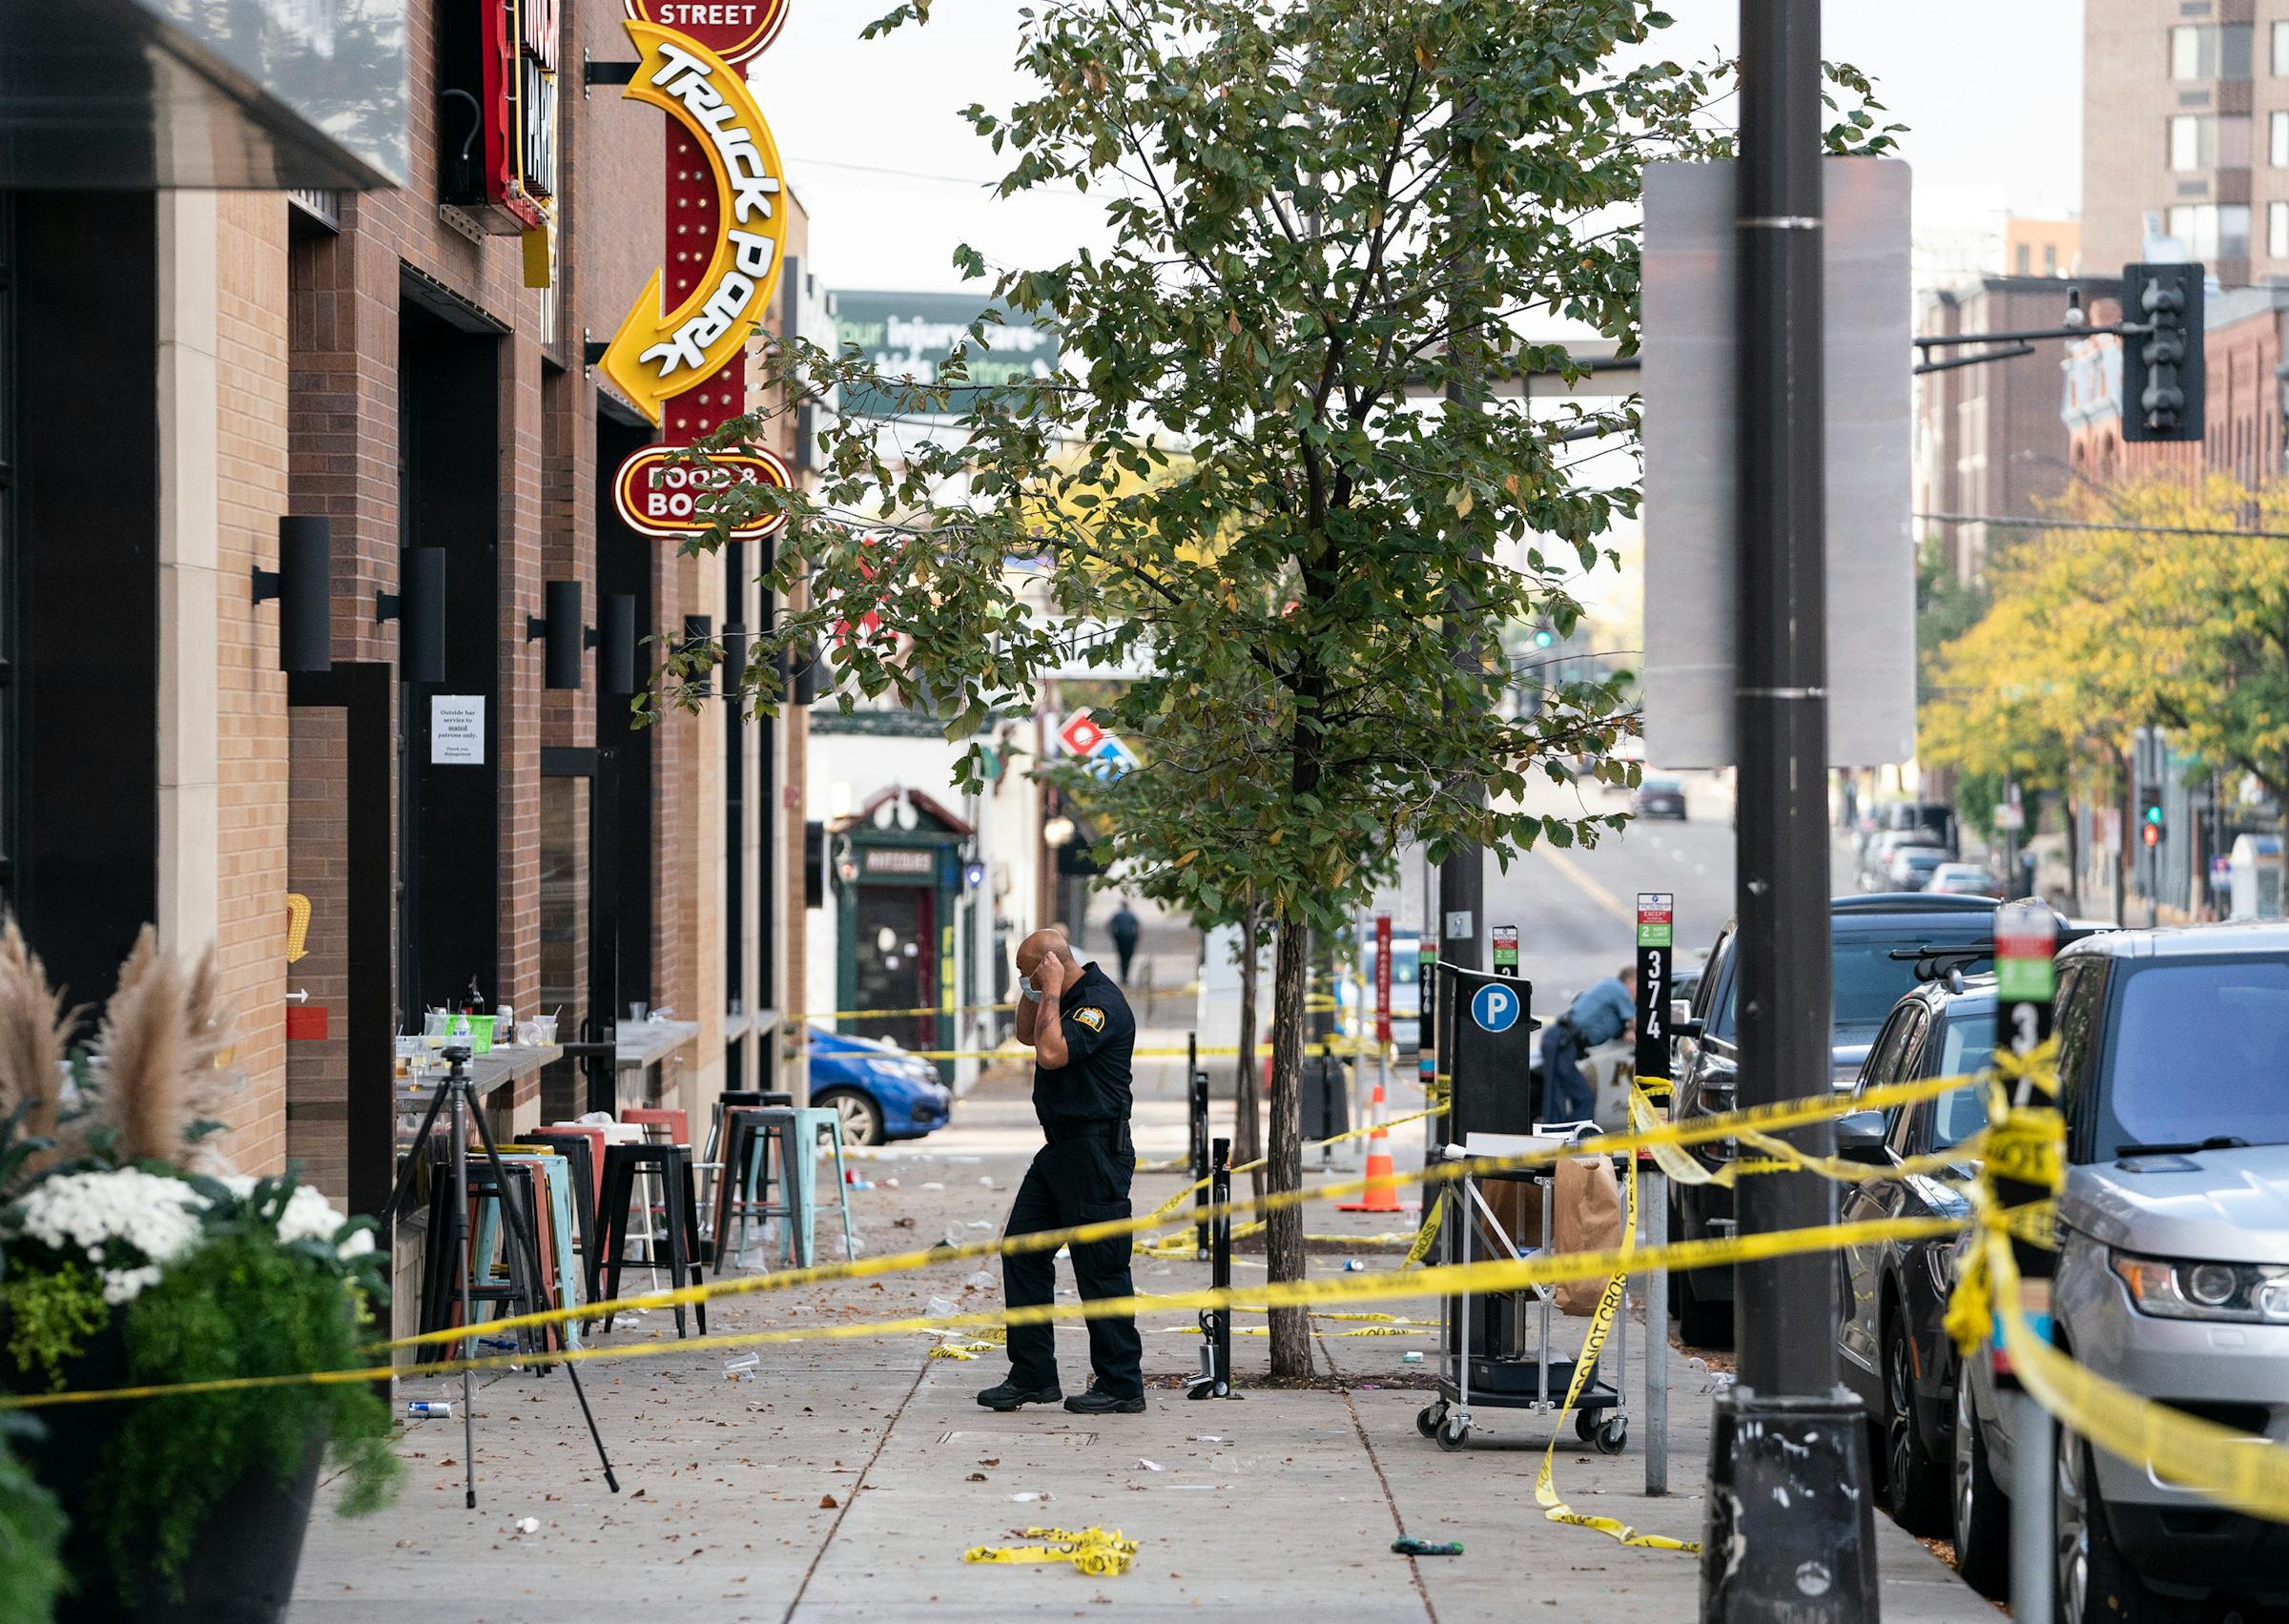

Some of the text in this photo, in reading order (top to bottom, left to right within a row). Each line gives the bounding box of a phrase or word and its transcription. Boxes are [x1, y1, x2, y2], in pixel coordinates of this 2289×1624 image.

[660, 4, 757, 25] STREET
[639, 41, 780, 378] TRUCK PARK
[648, 466, 732, 489] FOOD
[1641, 925, 1650, 937] 2
[1488, 993, 1508, 1025] P
[1646, 950, 1661, 1039] 374
[1409, 1221, 1437, 1262] CROSS
[1598, 1267, 1628, 1324] CROS
